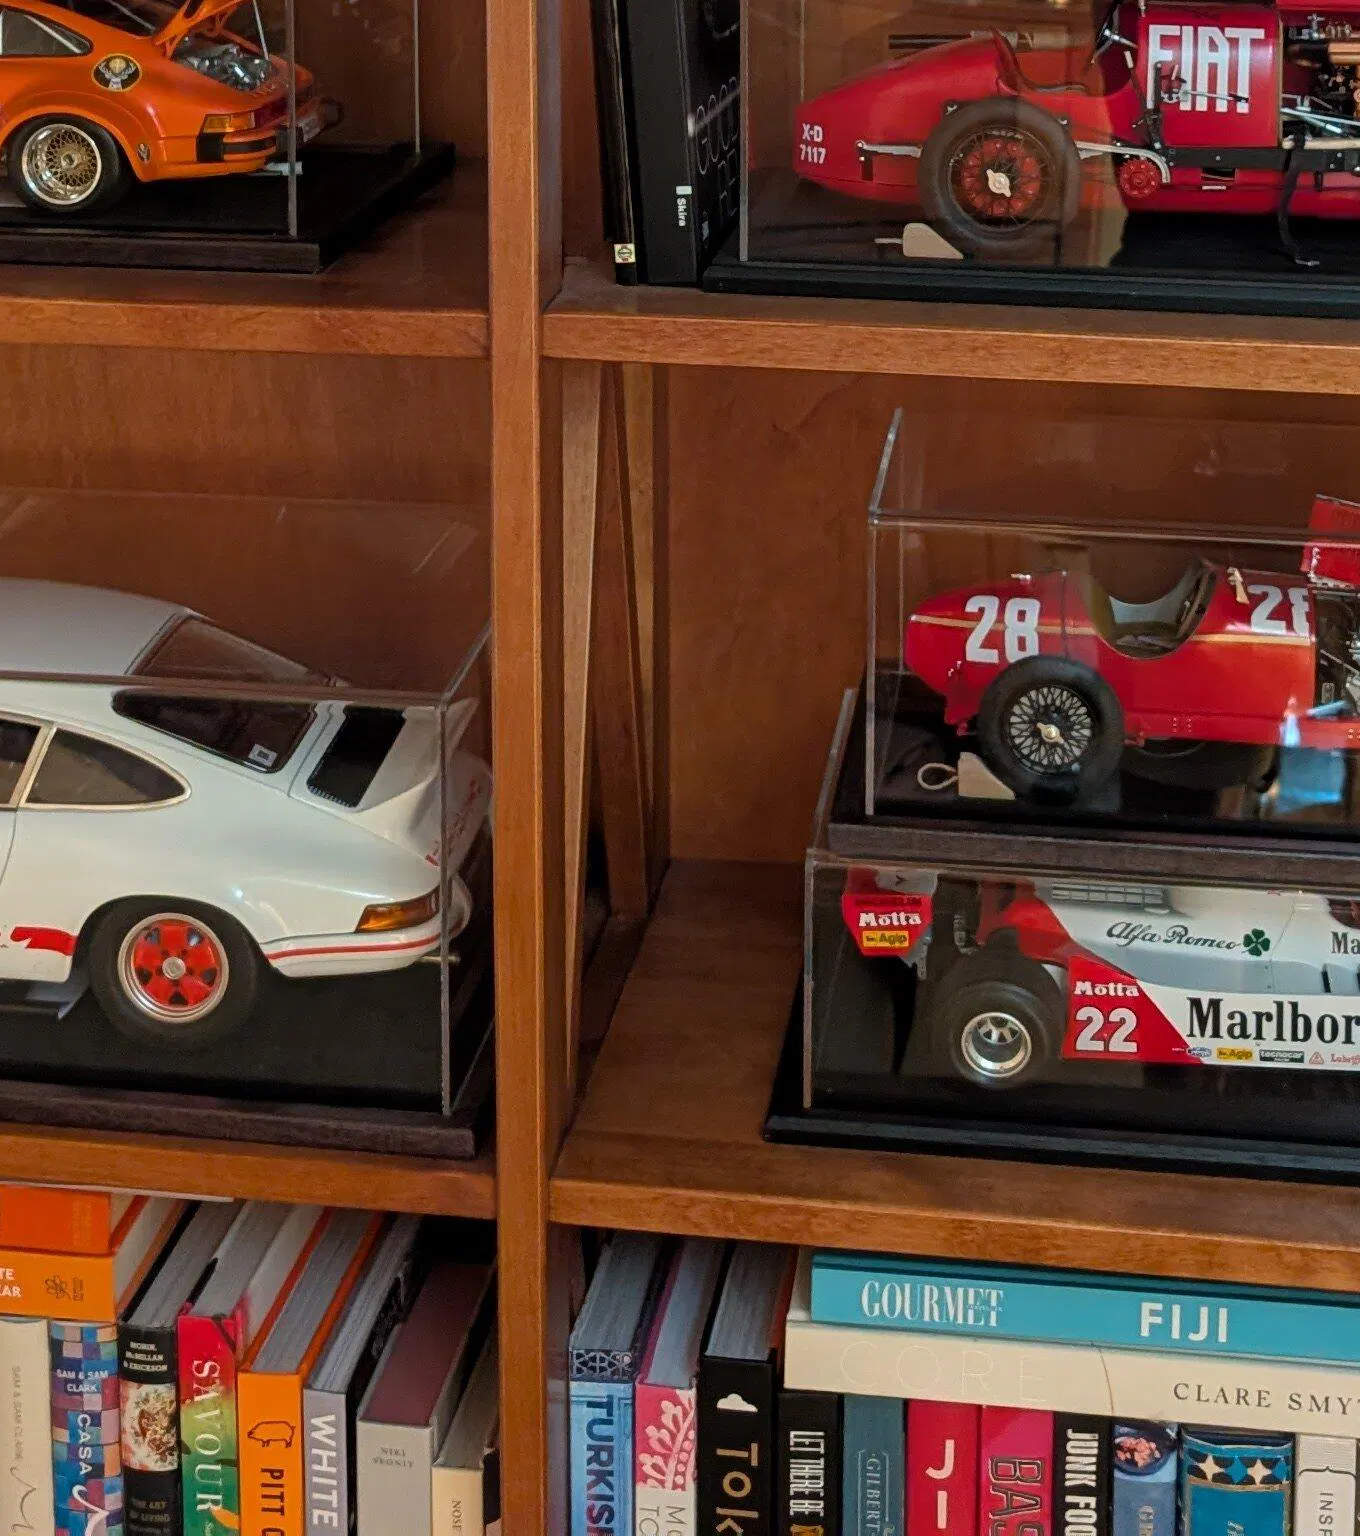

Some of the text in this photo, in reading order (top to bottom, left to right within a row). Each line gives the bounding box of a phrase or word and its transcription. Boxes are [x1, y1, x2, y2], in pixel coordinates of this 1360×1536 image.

[1148, 25, 1265, 113] FIAT
[800, 145, 827, 165] 7117
[677, 197, 688, 227] Skira
[964, 595, 1040, 663] 28
[858, 911, 922, 929] Motta
[1106, 921, 1242, 952] Alfa Romeo
[878, 932, 908, 948] Agip
[1073, 980, 1140, 998] Motta
[1075, 1006, 1139, 1053] 22
[1229, 1049, 1253, 1061] Agip
[1260, 1050, 1303, 1059] tecnocar
[861, 1279, 1227, 1344] GOURMET FIJI
[56, 1368, 75, 1379] SAM
[88, 1368, 109, 1379] SAM
[66, 1382, 97, 1393] CLARK
[1173, 1382, 1272, 1409] CLARE
[77, 1413, 93, 1475] CASA
[192, 1359, 224, 1512] SAVOUR
[310, 1415, 338, 1528] WHITE
[790, 1431, 825, 1517] LET THERE BE
[1064, 1428, 1099, 1488] JUNK
[260, 1468, 285, 1516] PITT
[865, 1457, 882, 1536] GILBERT
